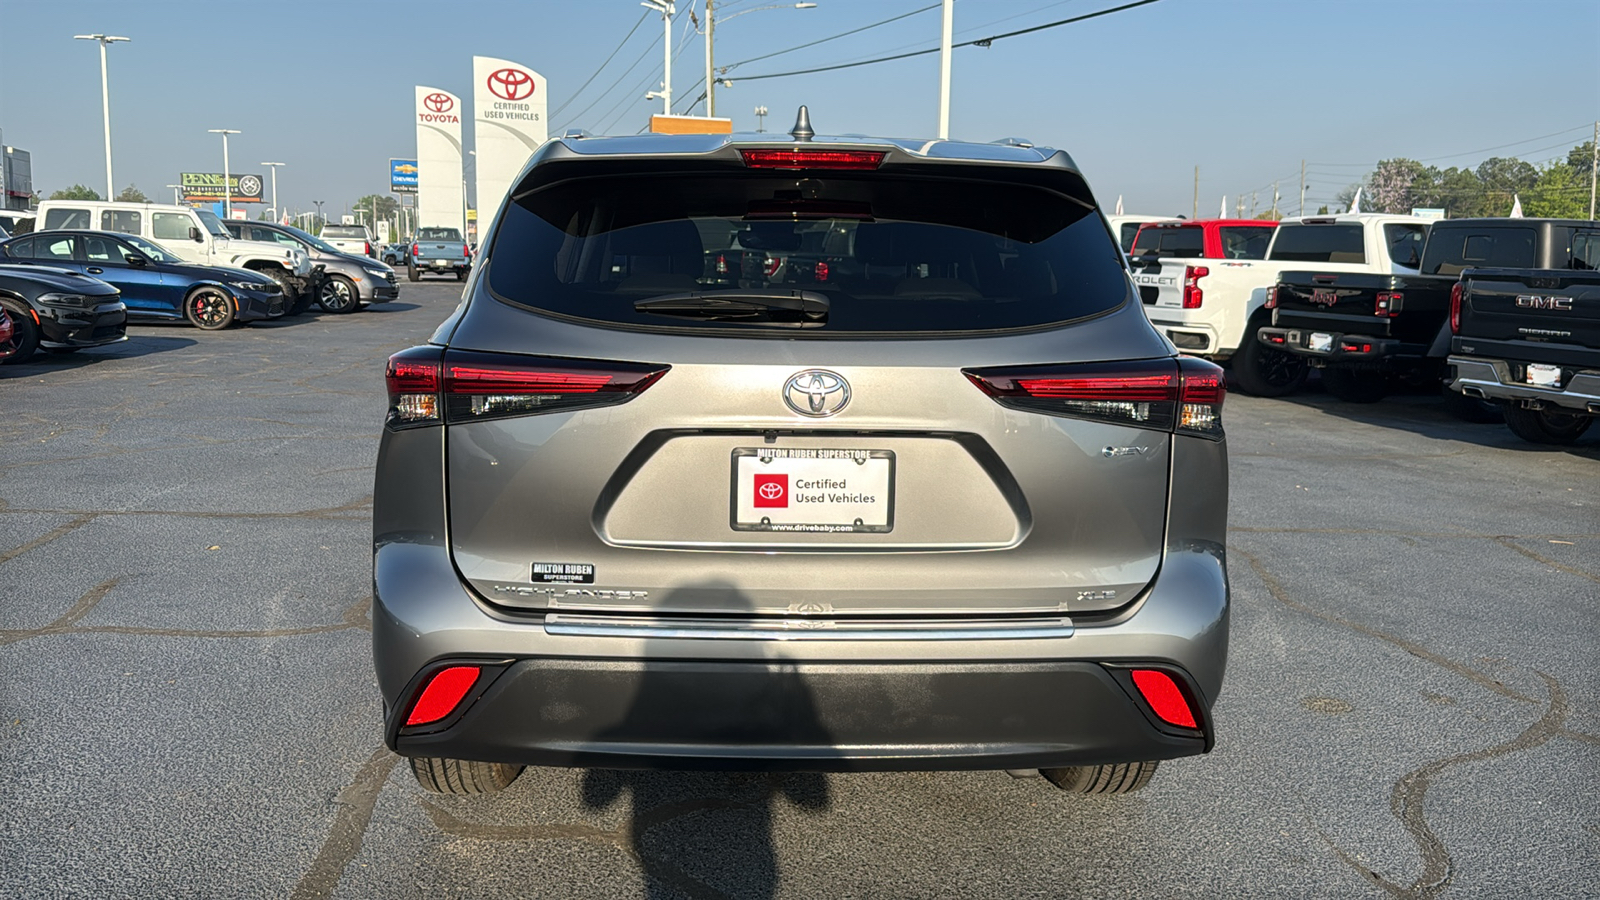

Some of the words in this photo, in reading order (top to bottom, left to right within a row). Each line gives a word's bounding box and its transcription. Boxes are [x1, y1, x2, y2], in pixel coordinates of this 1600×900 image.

[493, 102, 530, 111] CERTIFIED
[418, 113, 459, 124] TOYOTA
[484, 110, 504, 119] USED
[505, 112, 540, 121] VEHICLES
[1132, 276, 1176, 285] ROLET
[1309, 289, 1337, 307] Jeep
[1515, 294, 1573, 310] GMC
[757, 448, 787, 458] MILTON
[789, 449, 817, 458] RUBEN
[818, 449, 871, 459] SUPERSTORE
[796, 479, 846, 489] Certified
[796, 493, 825, 503] Used
[827, 493, 876, 503] Vehicles
[771, 524, 853, 533] www.drivebaby.com
[533, 563, 564, 574] MILTON
[564, 564, 593, 575] RUBEN
[494, 585, 649, 600] HIGHLANDER
[1076, 590, 1116, 601] XLE
